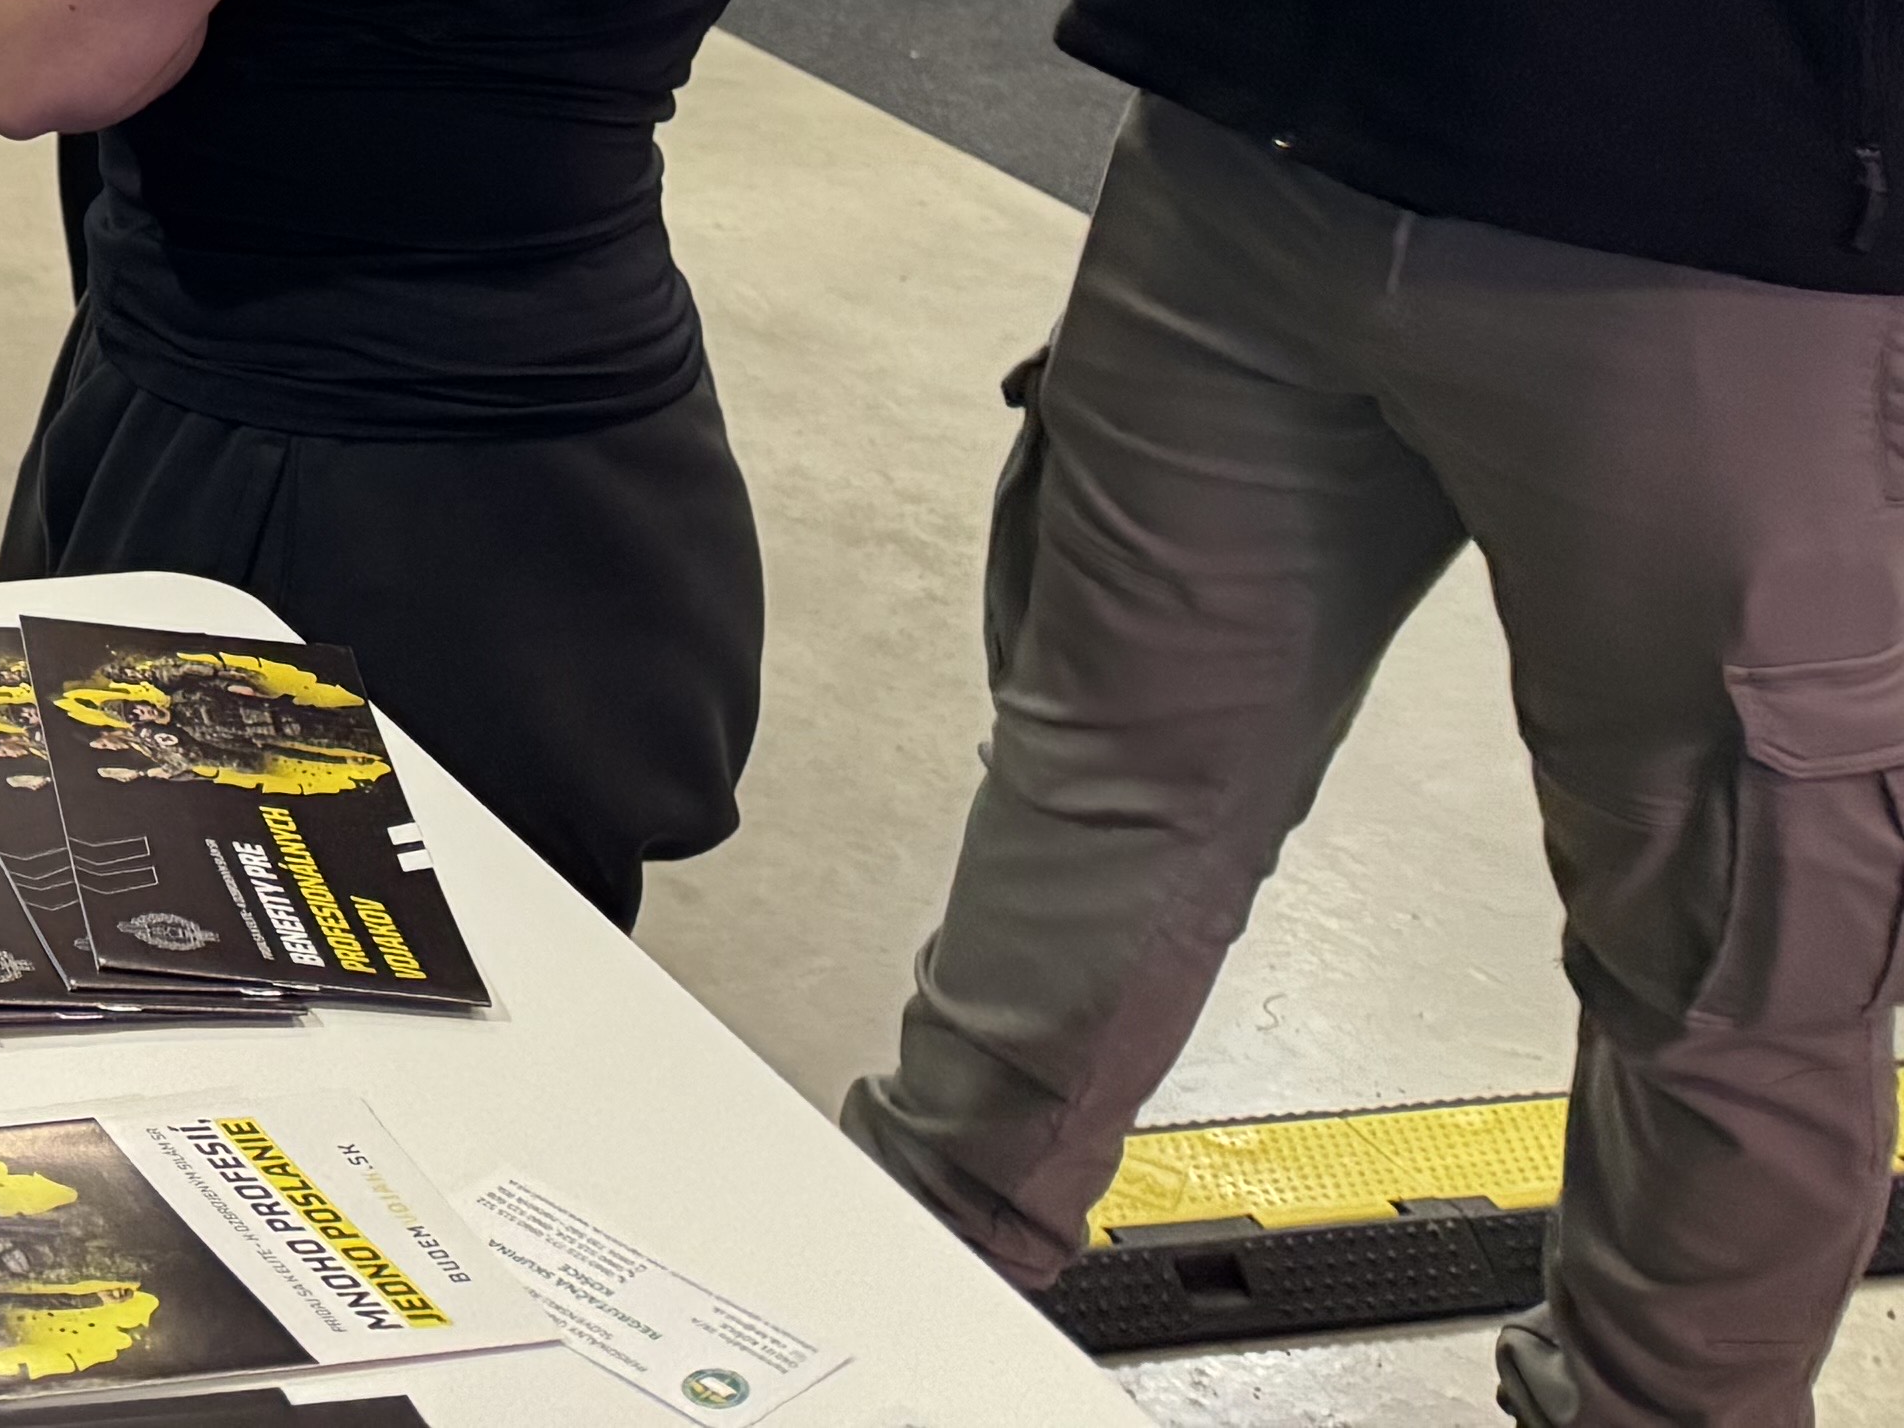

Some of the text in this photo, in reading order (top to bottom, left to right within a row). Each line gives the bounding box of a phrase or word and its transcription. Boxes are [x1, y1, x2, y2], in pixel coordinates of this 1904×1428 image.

[233, 841, 278, 880] PRE
[258, 805, 376, 974] PROFESIONÁLNYCH
[254, 875, 325, 968] BENEFITY
[350, 896, 428, 980] VOJAKOV
[221, 1122, 446, 1322] JEDNO POSLANIE
[488, 1238, 559, 1278] SKUPINA
[286, 1240, 403, 1329] MNOHO
